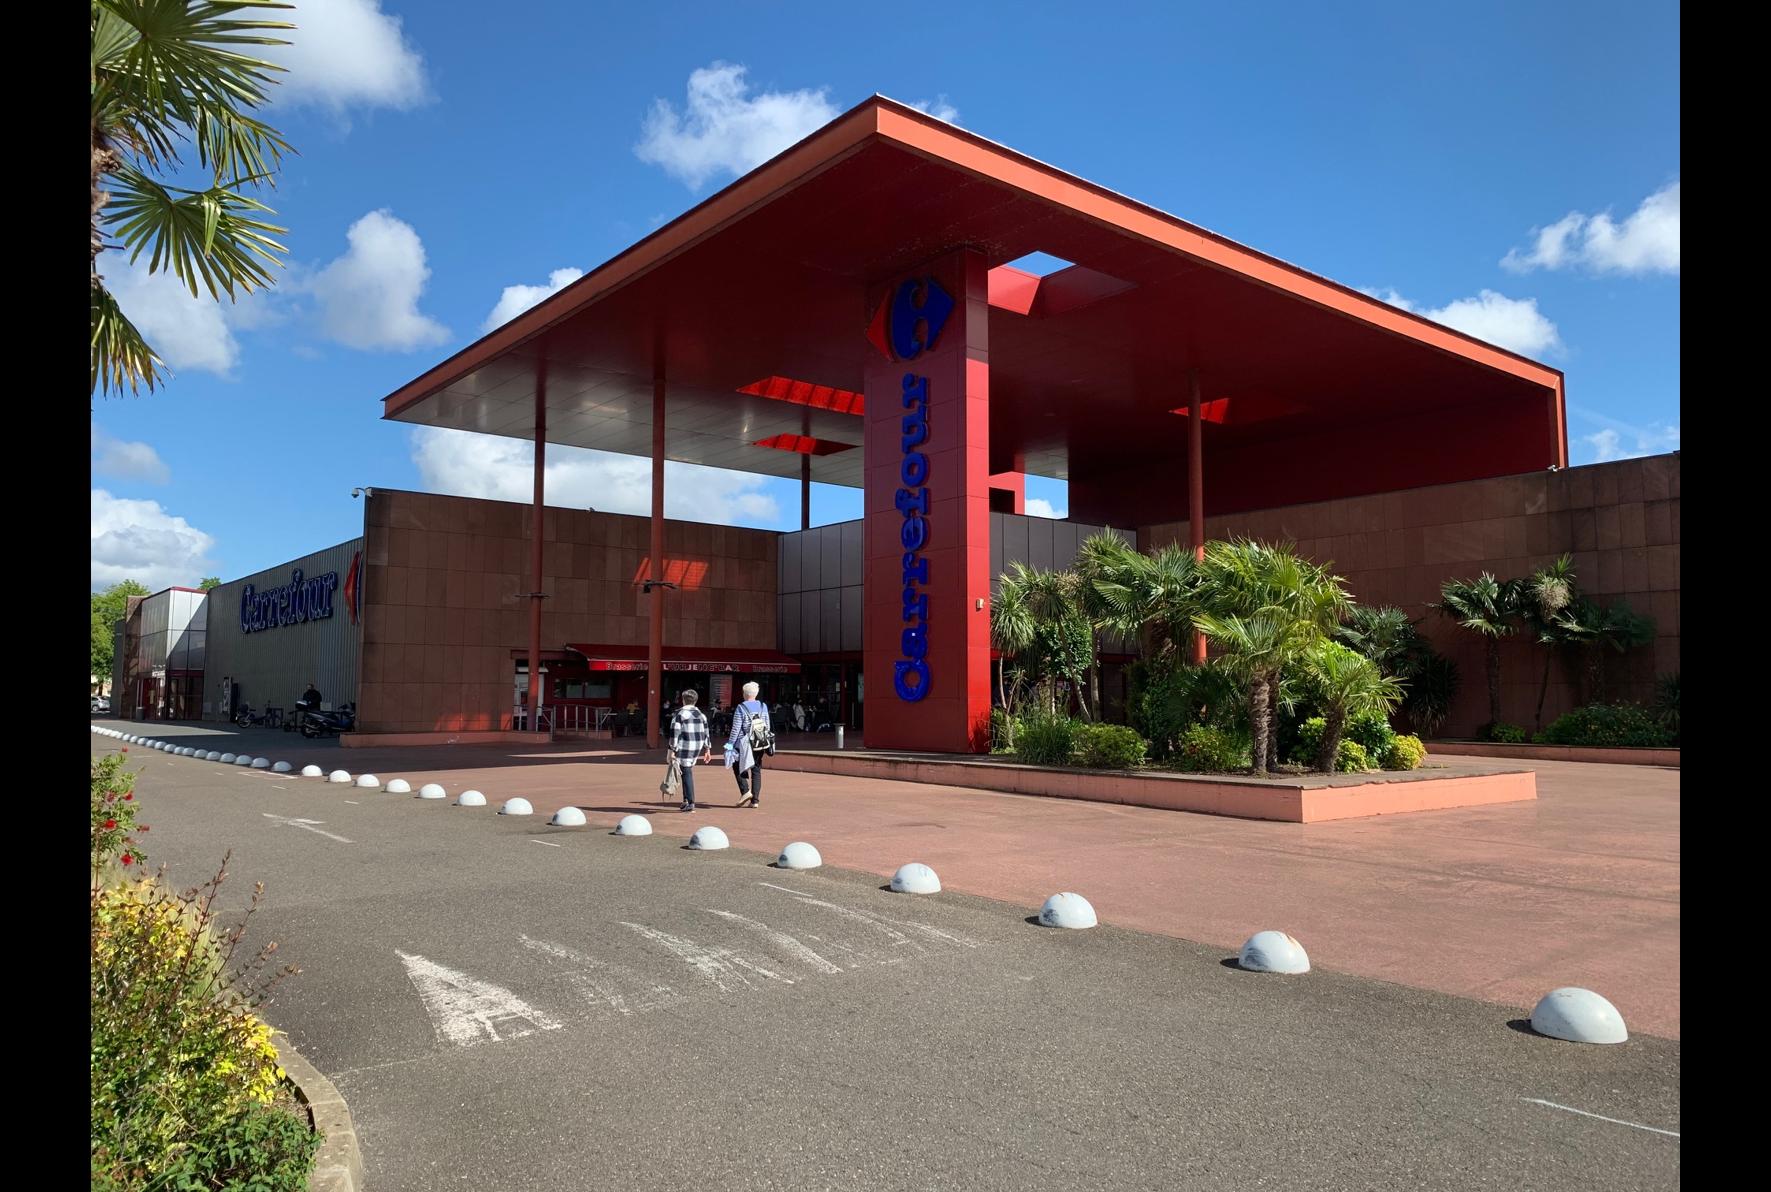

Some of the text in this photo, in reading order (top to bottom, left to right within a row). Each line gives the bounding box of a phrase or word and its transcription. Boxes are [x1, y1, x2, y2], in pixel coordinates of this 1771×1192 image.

[894, 372, 930, 703] Carrefour
[240, 568, 338, 634] Carrefour
[606, 661, 648, 671] Brasserie
